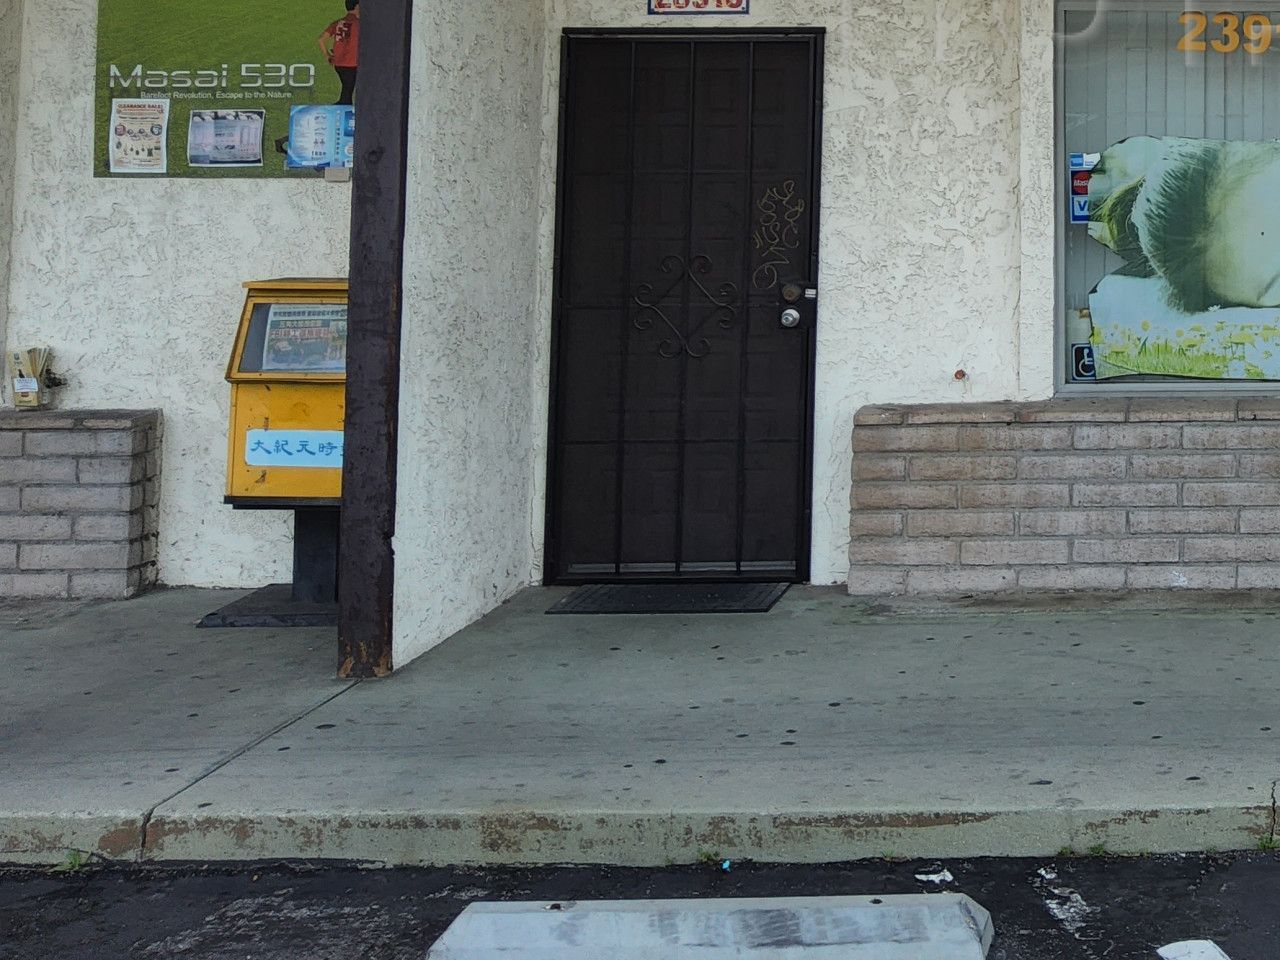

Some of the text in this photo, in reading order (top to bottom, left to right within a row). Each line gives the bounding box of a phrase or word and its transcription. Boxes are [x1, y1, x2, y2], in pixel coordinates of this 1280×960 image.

[109, 63, 316, 88] Masai 530
[250, 440, 344, 456] 大紀元時
